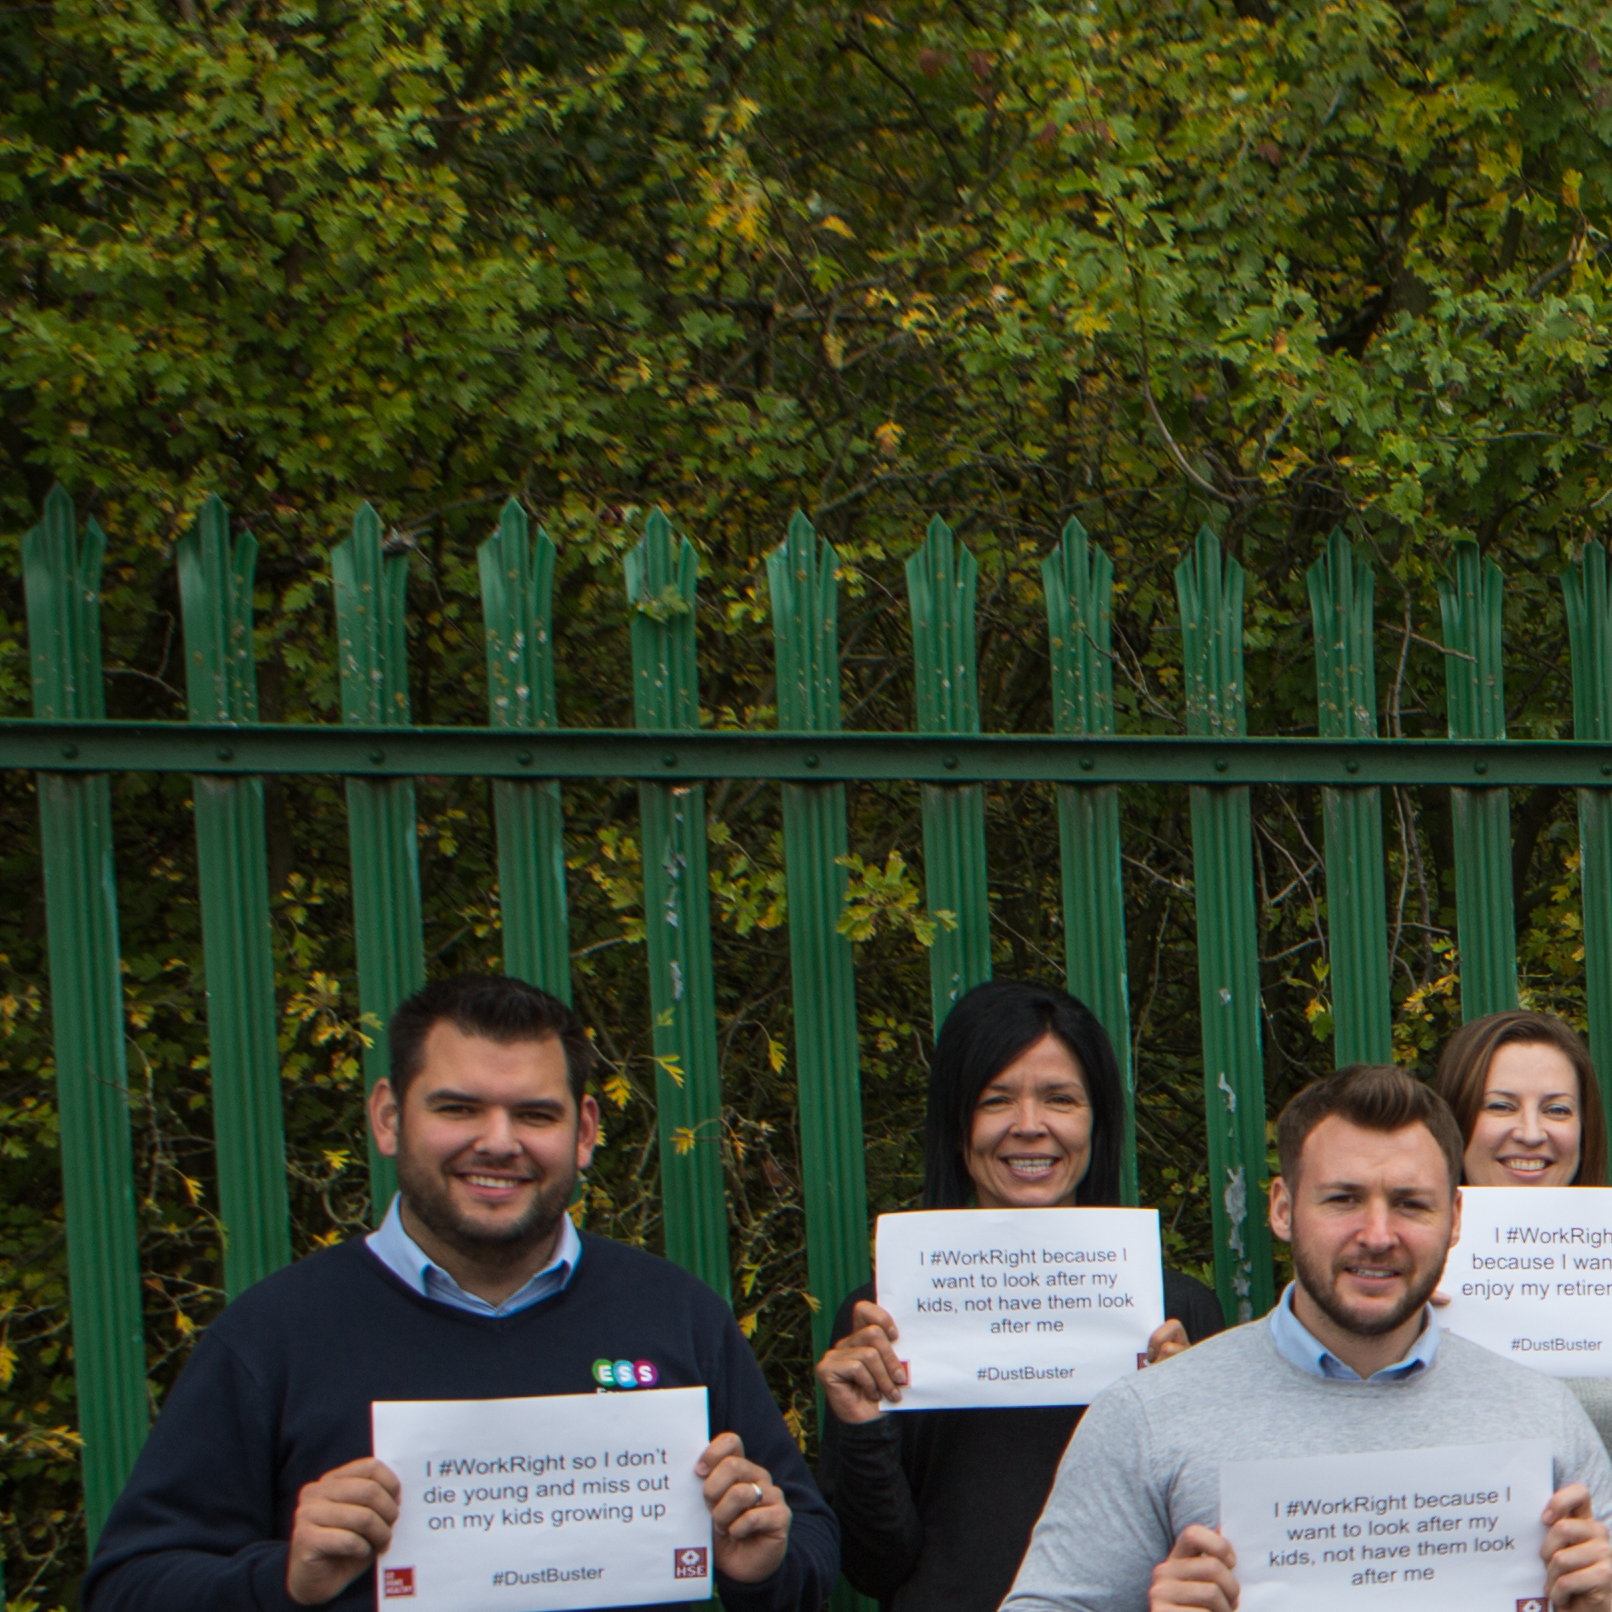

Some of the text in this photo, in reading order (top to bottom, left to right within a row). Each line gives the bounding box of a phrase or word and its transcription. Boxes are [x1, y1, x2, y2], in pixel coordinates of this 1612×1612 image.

[930, 1249, 1117, 1268] #WorkRight because
[1472, 1253, 1555, 1270] because
[931, 1271, 1117, 1289] want to look after my
[1462, 1283, 1515, 1301] enjoy
[1521, 1283, 1550, 1300] my
[917, 1293, 1134, 1313] kids, not have them look
[990, 1318, 1064, 1334] after me
[1511, 1338, 1603, 1351] #DustBuster
[977, 1366, 1075, 1381] #DustBuster
[439, 1455, 565, 1476] #WorkRight
[572, 1456, 597, 1470] so
[423, 1474, 670, 1507] die young and miss out
[1286, 1491, 1499, 1517] #WorkRight because
[428, 1503, 666, 1532] on my kids growing up
[1287, 1516, 1498, 1541] want to look after my
[1269, 1535, 1515, 1567] kids, not have them look
[492, 1567, 604, 1586] #DustBuster
[676, 1567, 706, 1577] HSE
[1351, 1567, 1435, 1586] after me
